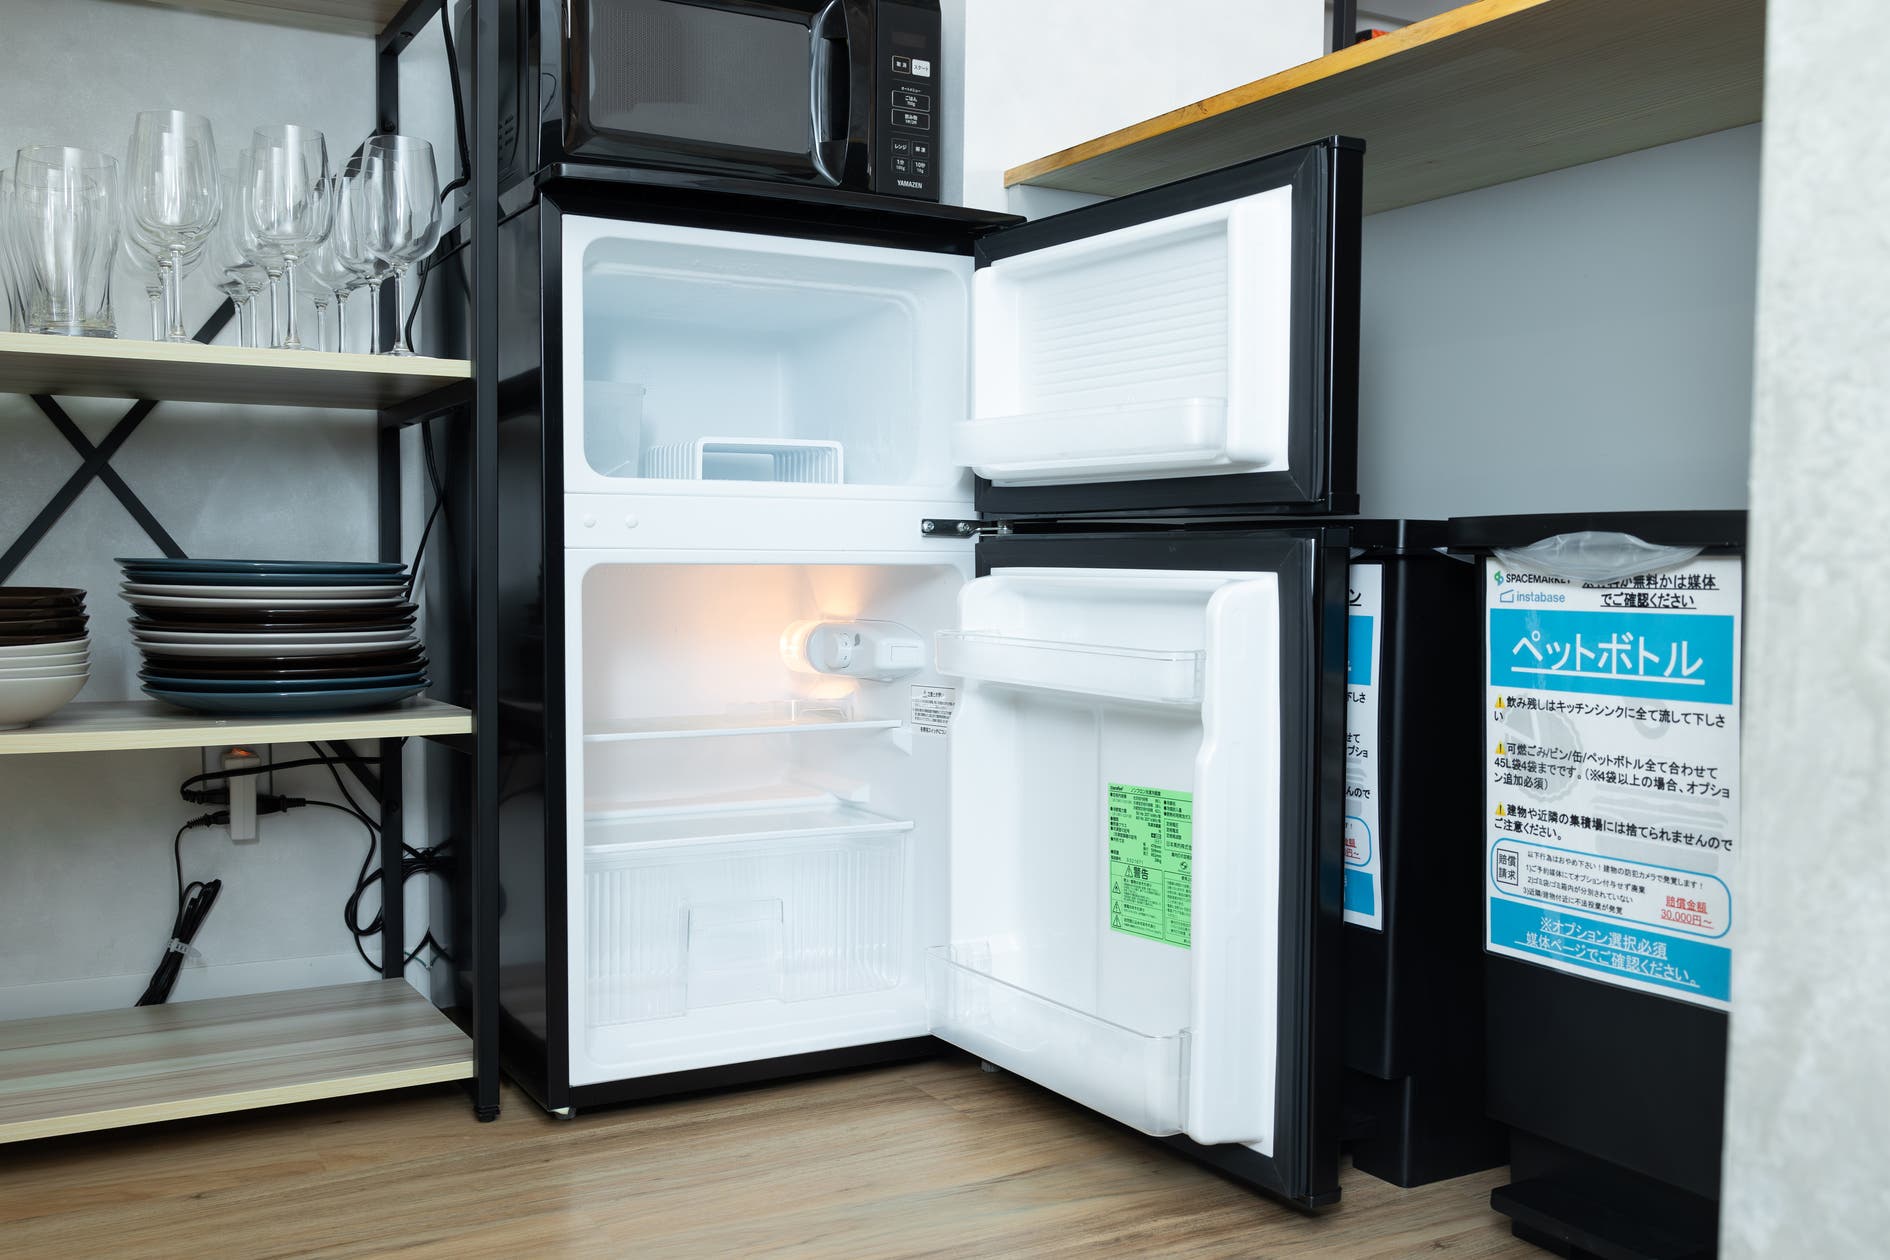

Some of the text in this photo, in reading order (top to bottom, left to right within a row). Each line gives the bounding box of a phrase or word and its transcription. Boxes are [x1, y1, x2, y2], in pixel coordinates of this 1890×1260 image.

[897, 179, 923, 189] YAMAZEN
[1582, 573, 1717, 589] か無料かは媒体
[1517, 590, 1565, 603] instabase
[1600, 591, 1695, 608] でご確認ください
[1512, 630, 1703, 677] ペットボトル
[1494, 712, 1504, 722] い
[1506, 695, 1726, 728] 飲み残しはキッチンシンクに全て流して下しさ
[1494, 820, 1562, 841] ご注意ください。
[1506, 803, 1733, 852] 建物や近隣の集積場には捨てられませんので
[1499, 853, 1517, 867] 賠償
[1133, 866, 1149, 880] 警告
[1499, 867, 1517, 880] 請求
[1666, 896, 1708, 914] 賠償金額
[1540, 917, 1668, 960] ※オプション選択必須
[1526, 931, 1697, 986] 媒体ページでご確認ください。
